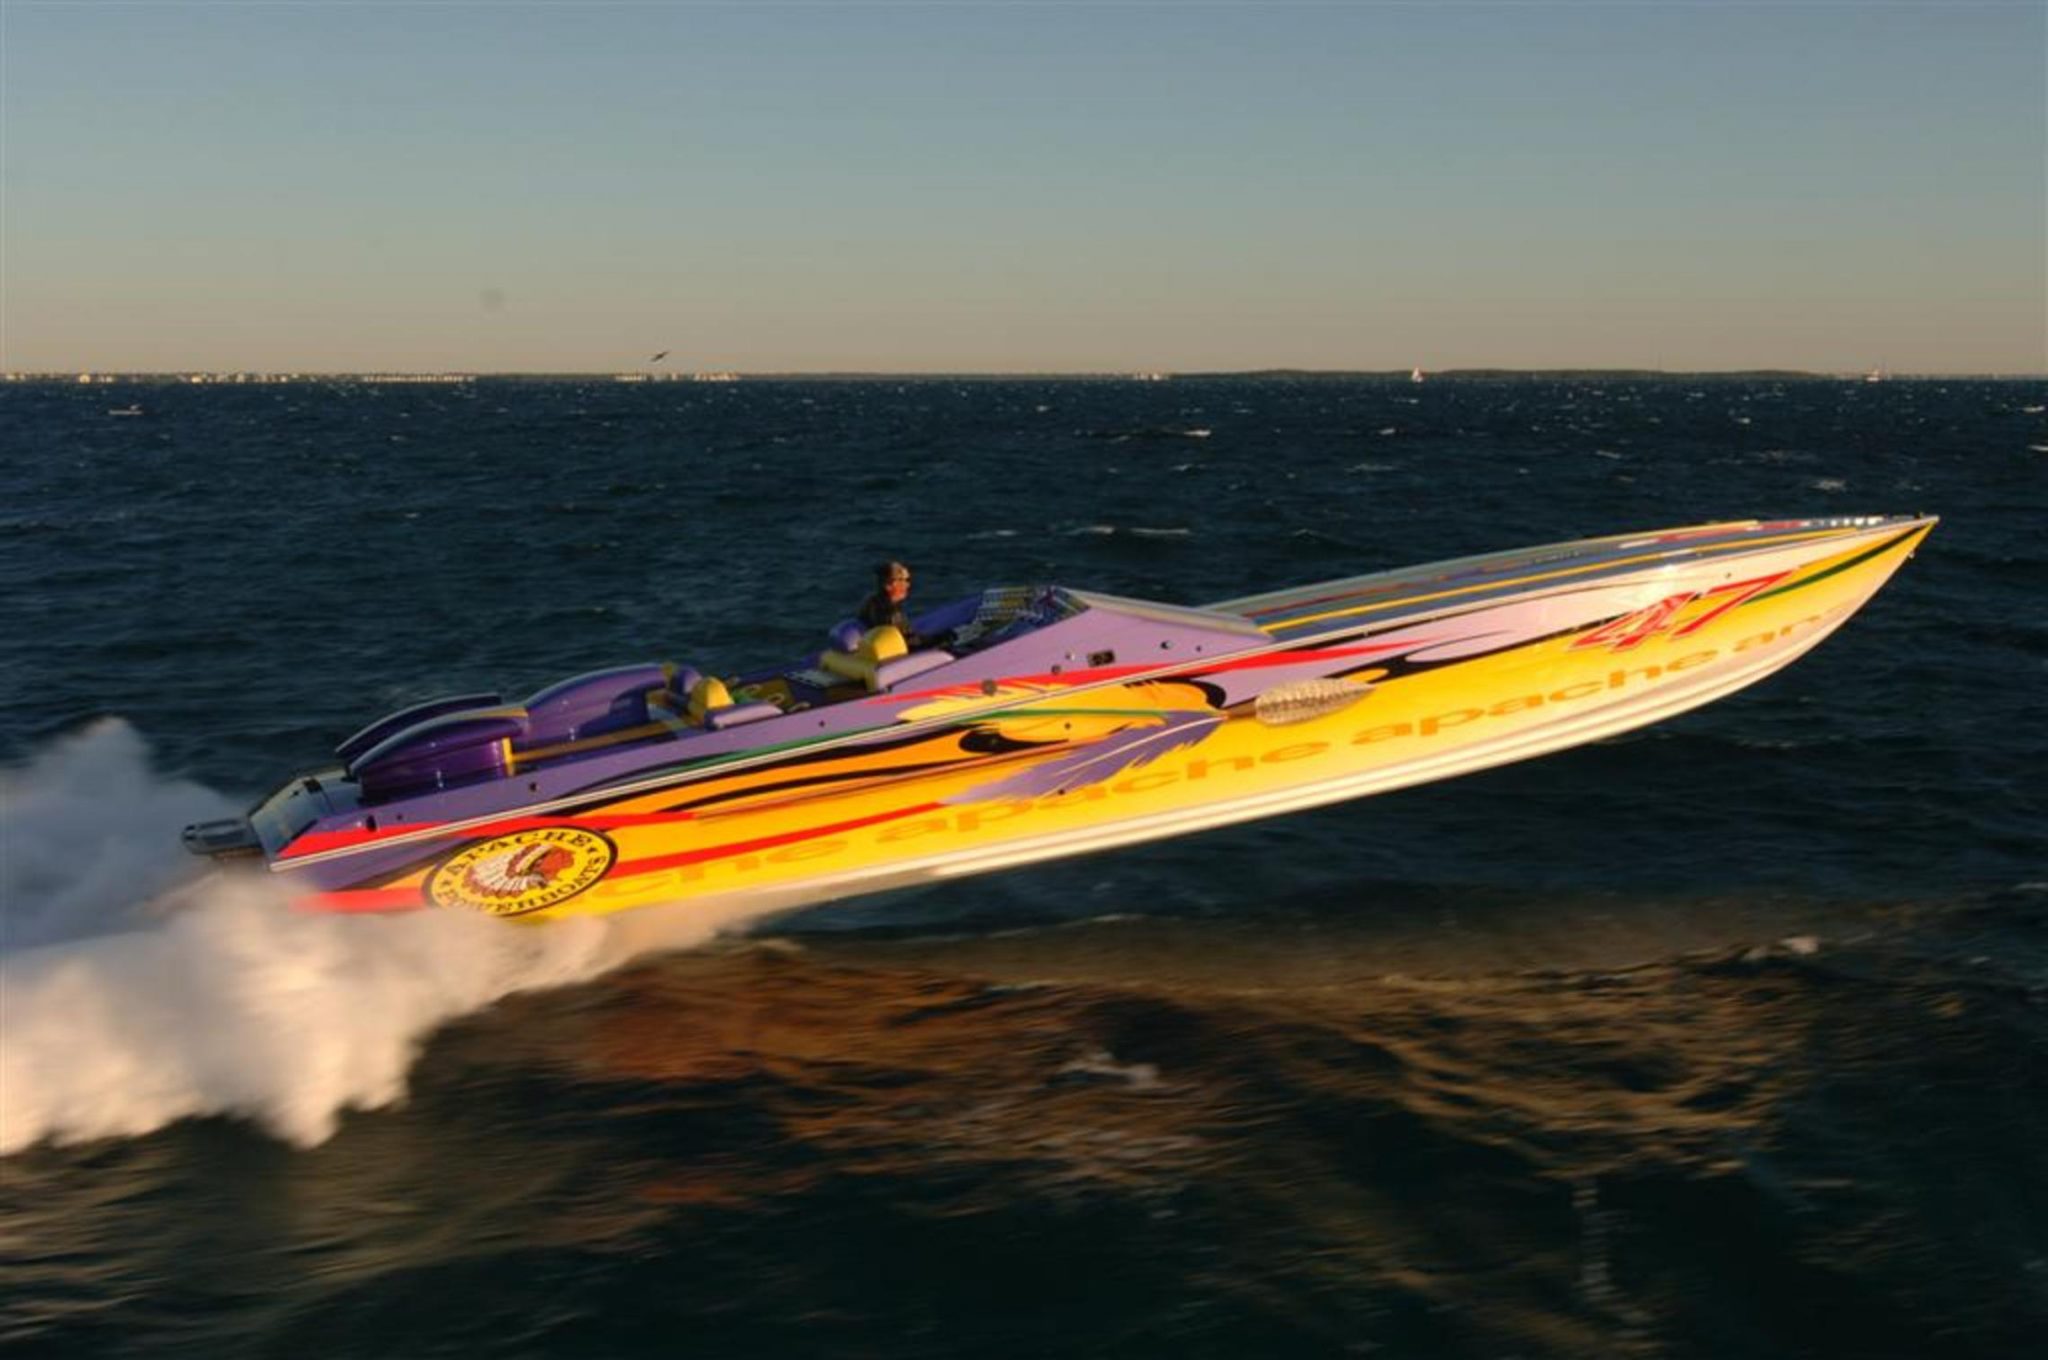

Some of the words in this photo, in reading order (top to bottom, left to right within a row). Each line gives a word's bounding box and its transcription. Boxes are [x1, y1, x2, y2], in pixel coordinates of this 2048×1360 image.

[875, 742, 1331, 843] apache
[1350, 649, 1719, 745] apache
[446, 831, 592, 876] APACHE
